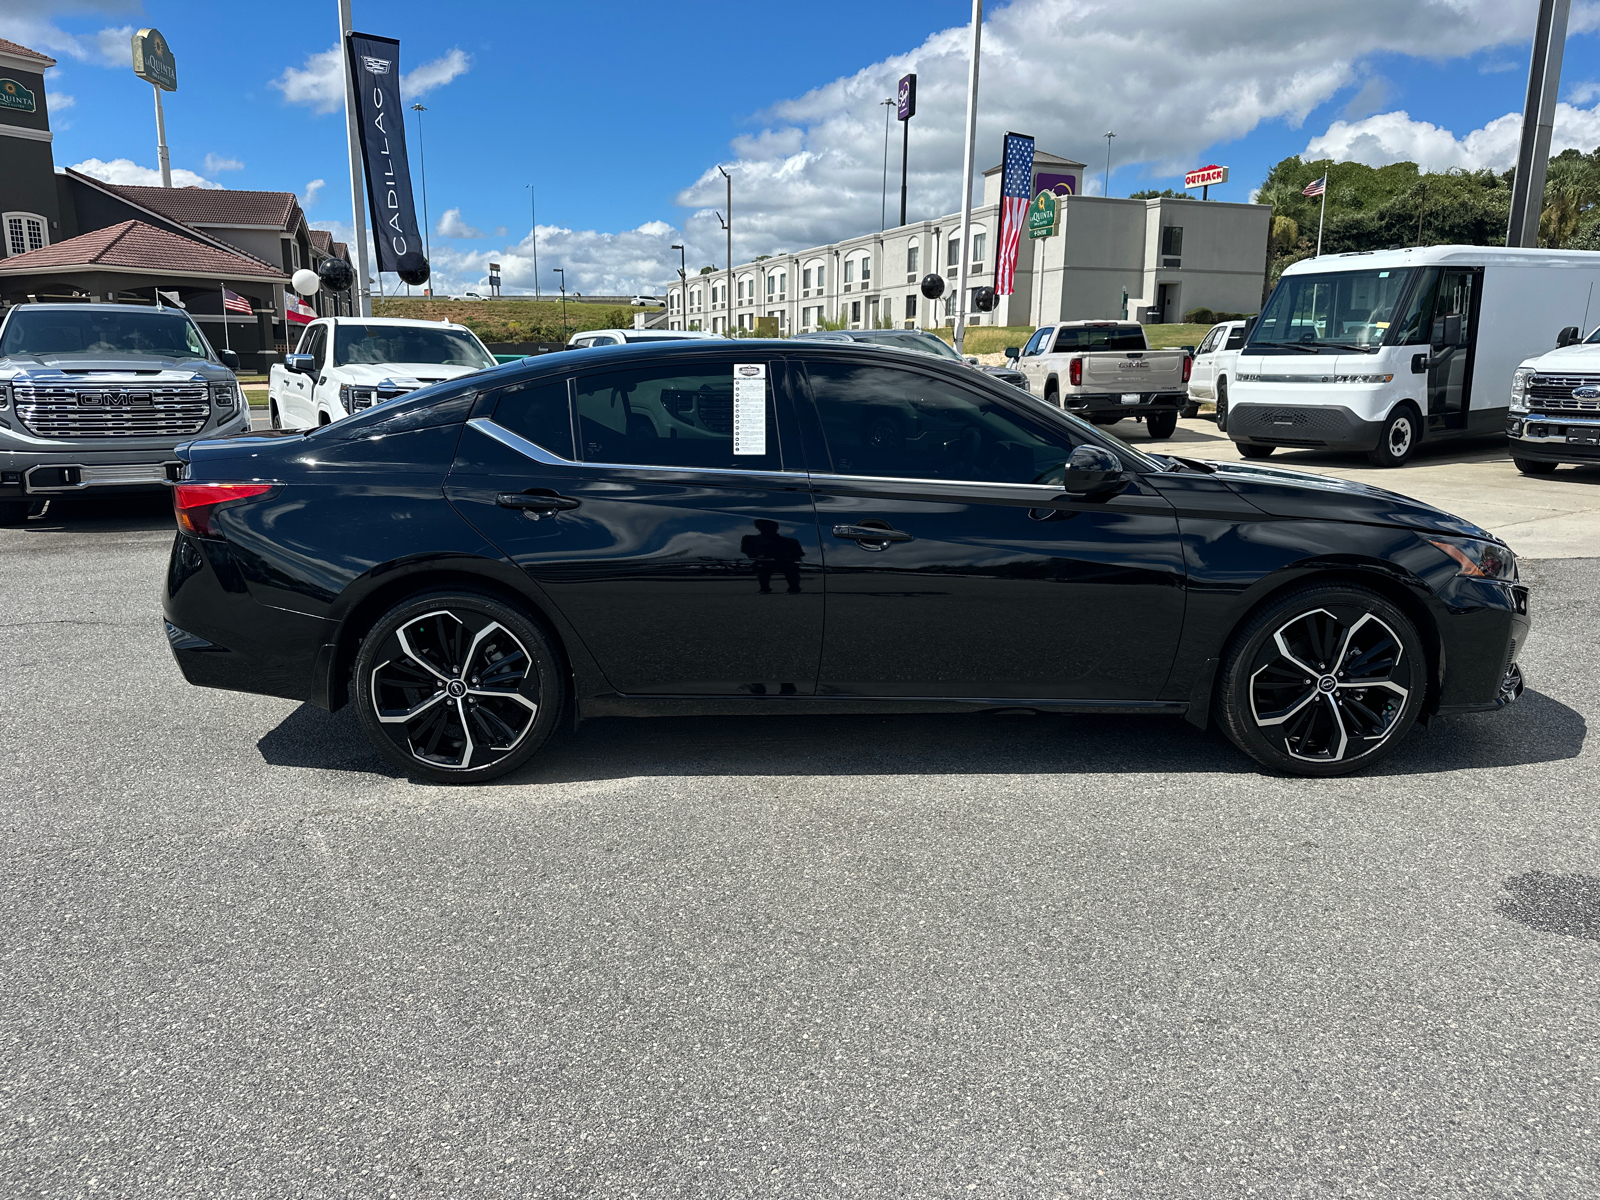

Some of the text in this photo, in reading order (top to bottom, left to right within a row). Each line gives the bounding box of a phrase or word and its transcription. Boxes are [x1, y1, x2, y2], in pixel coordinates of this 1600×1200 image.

[0, 92, 33, 106] QUINTA
[373, 87, 407, 256] CADILLAC
[1185, 170, 1222, 185] OUTBACK
[1033, 210, 1053, 223] QUINTA
[1119, 361, 1149, 369] GMC
[80, 393, 151, 406] GMC
